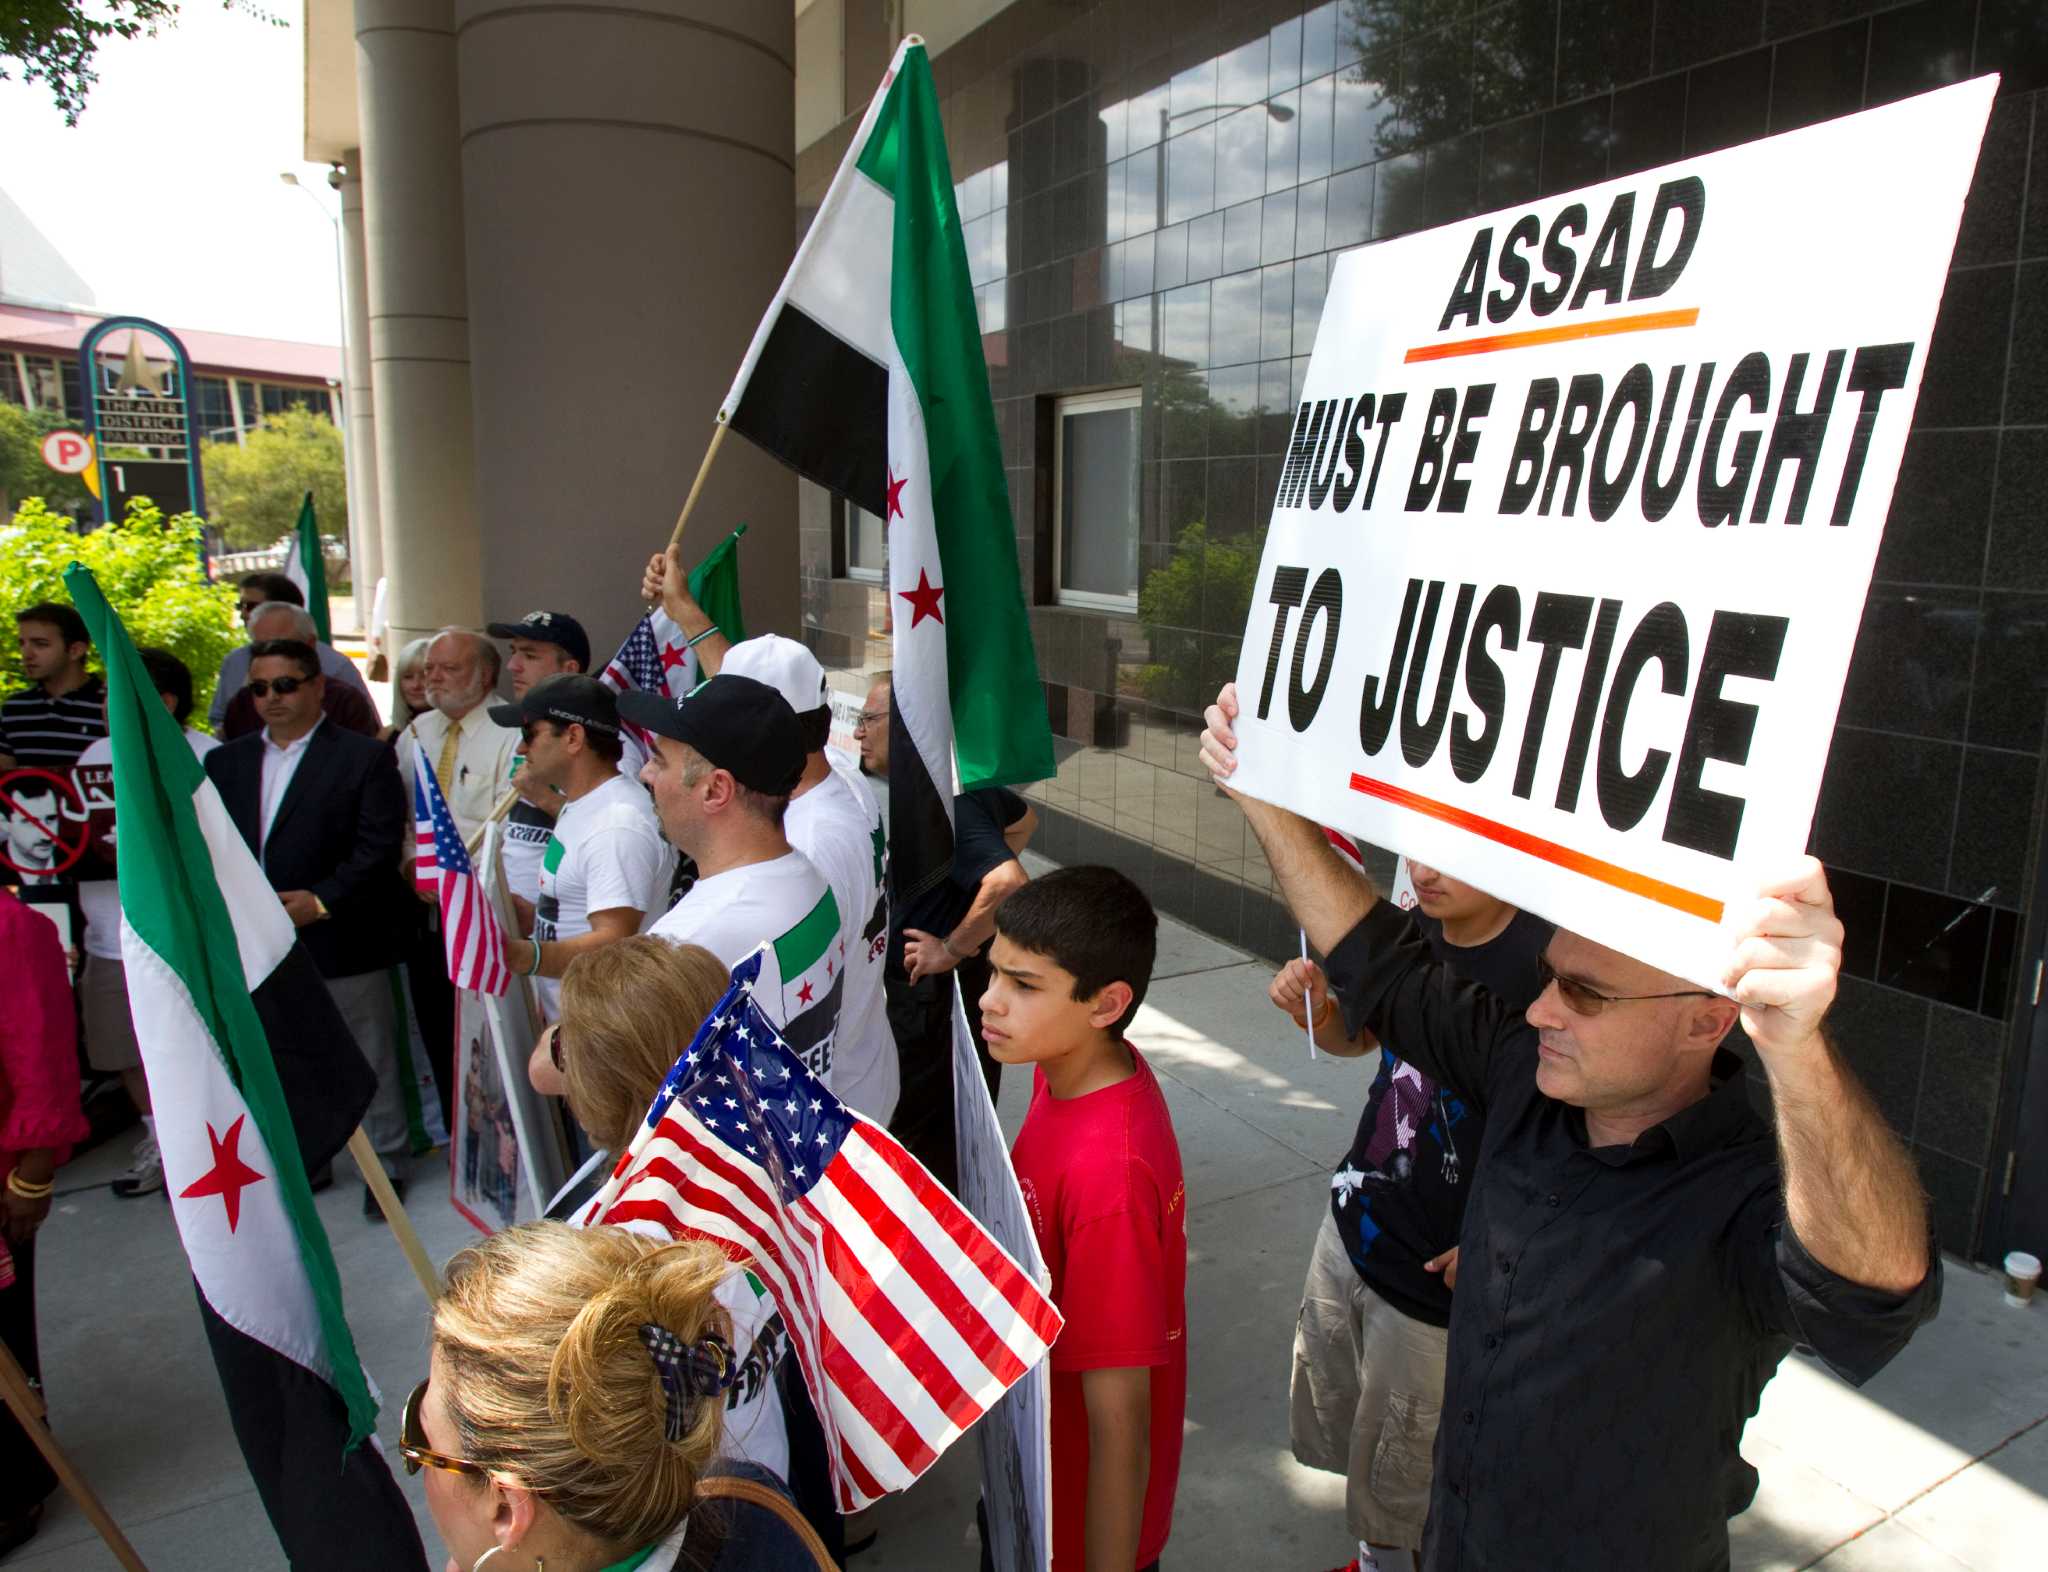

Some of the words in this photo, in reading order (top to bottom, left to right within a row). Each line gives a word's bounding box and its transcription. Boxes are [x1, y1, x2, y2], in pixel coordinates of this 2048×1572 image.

[1438, 176, 1706, 331] ASSAD
[57, 440, 82, 465] P
[103, 415, 180, 430] DISTRICT
[1276, 392, 1408, 513] MUST
[1404, 383, 1497, 513] BE
[1497, 342, 1915, 528] BROUGHT
[112, 466, 125, 492] 1
[1257, 565, 1343, 733] TO
[1360, 578, 1790, 861] JUSTICE
